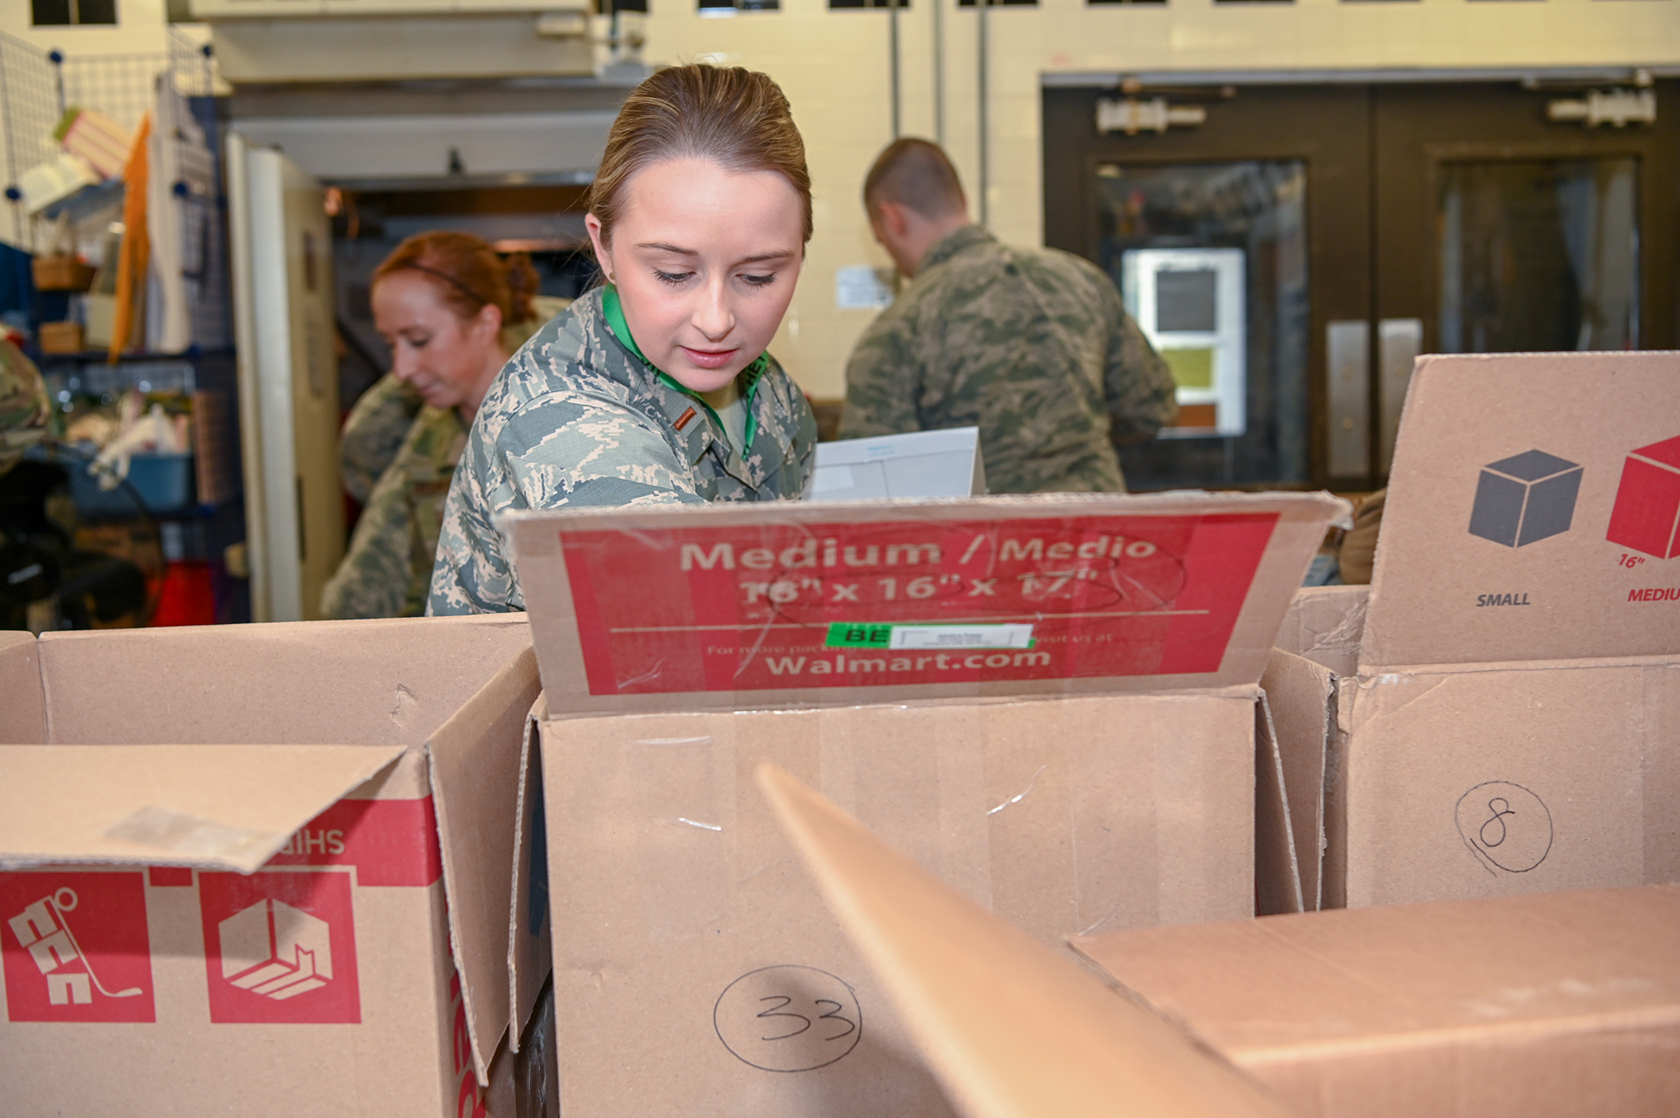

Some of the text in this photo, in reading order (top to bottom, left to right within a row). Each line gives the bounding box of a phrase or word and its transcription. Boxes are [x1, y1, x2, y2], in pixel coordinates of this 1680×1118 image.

[680, 533, 1157, 571] Medium / Medio
[1618, 553, 1646, 569] 16"
[739, 569, 1099, 604] 16" x 16" x 17"
[1476, 592, 1531, 607] SMALL
[707, 645, 733, 655] For
[1072, 634, 1092, 643] us
[1095, 633, 1112, 643] at
[765, 651, 1051, 676] Walmart.com
[1479, 797, 1516, 848] 8
[756, 995, 856, 1041] 33
